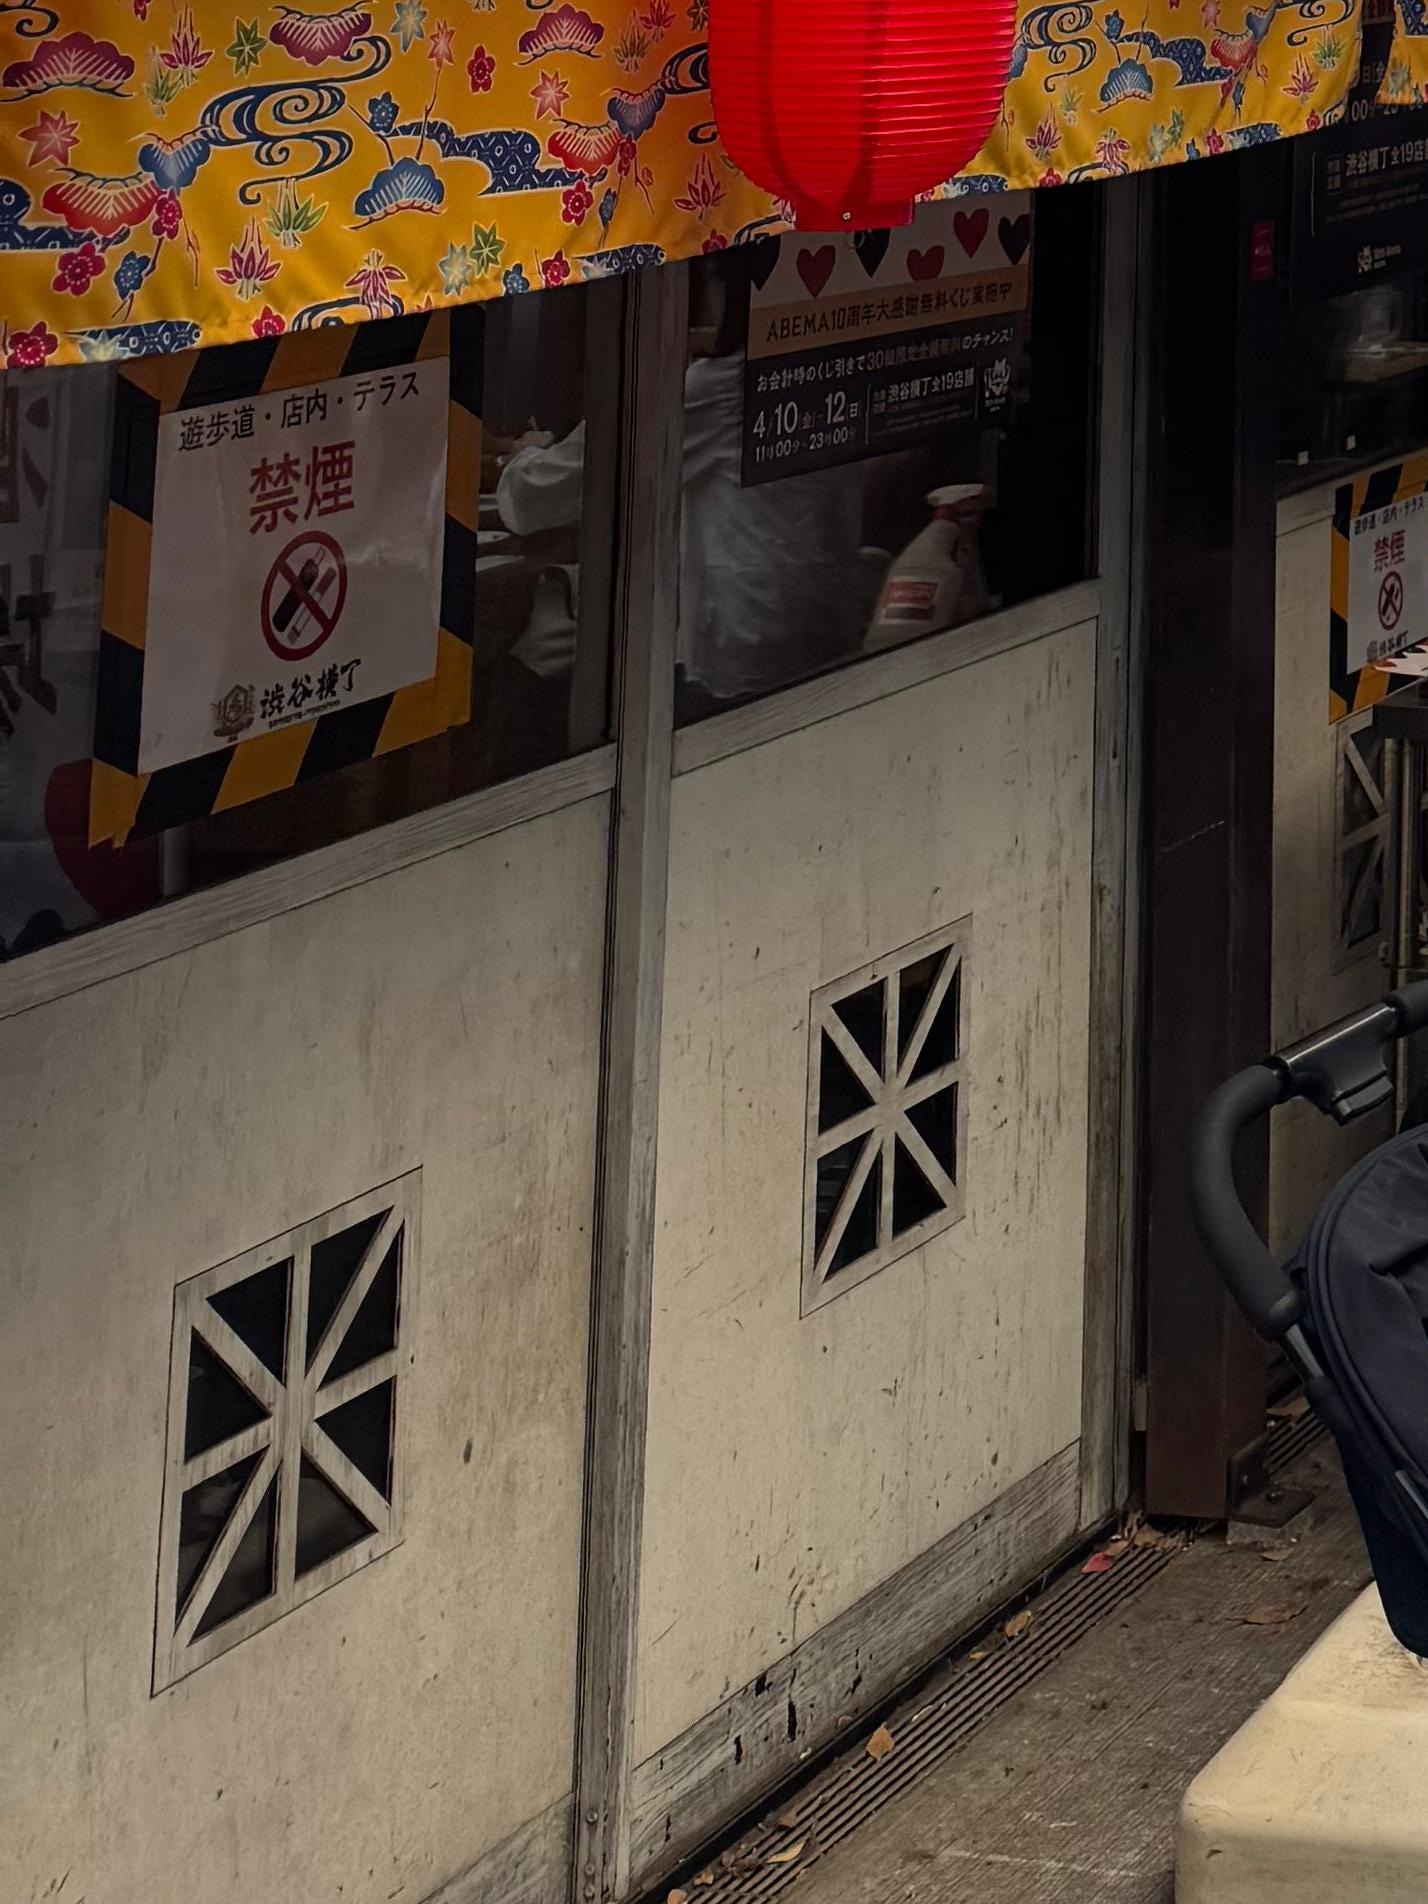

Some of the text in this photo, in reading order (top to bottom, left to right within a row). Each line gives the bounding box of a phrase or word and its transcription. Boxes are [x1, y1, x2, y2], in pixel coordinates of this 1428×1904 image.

[178, 371, 420, 452] 遊歩道・店内・テラス
[248, 439, 357, 536] 禁煙
[259, 658, 363, 721] 渋谷横丁
